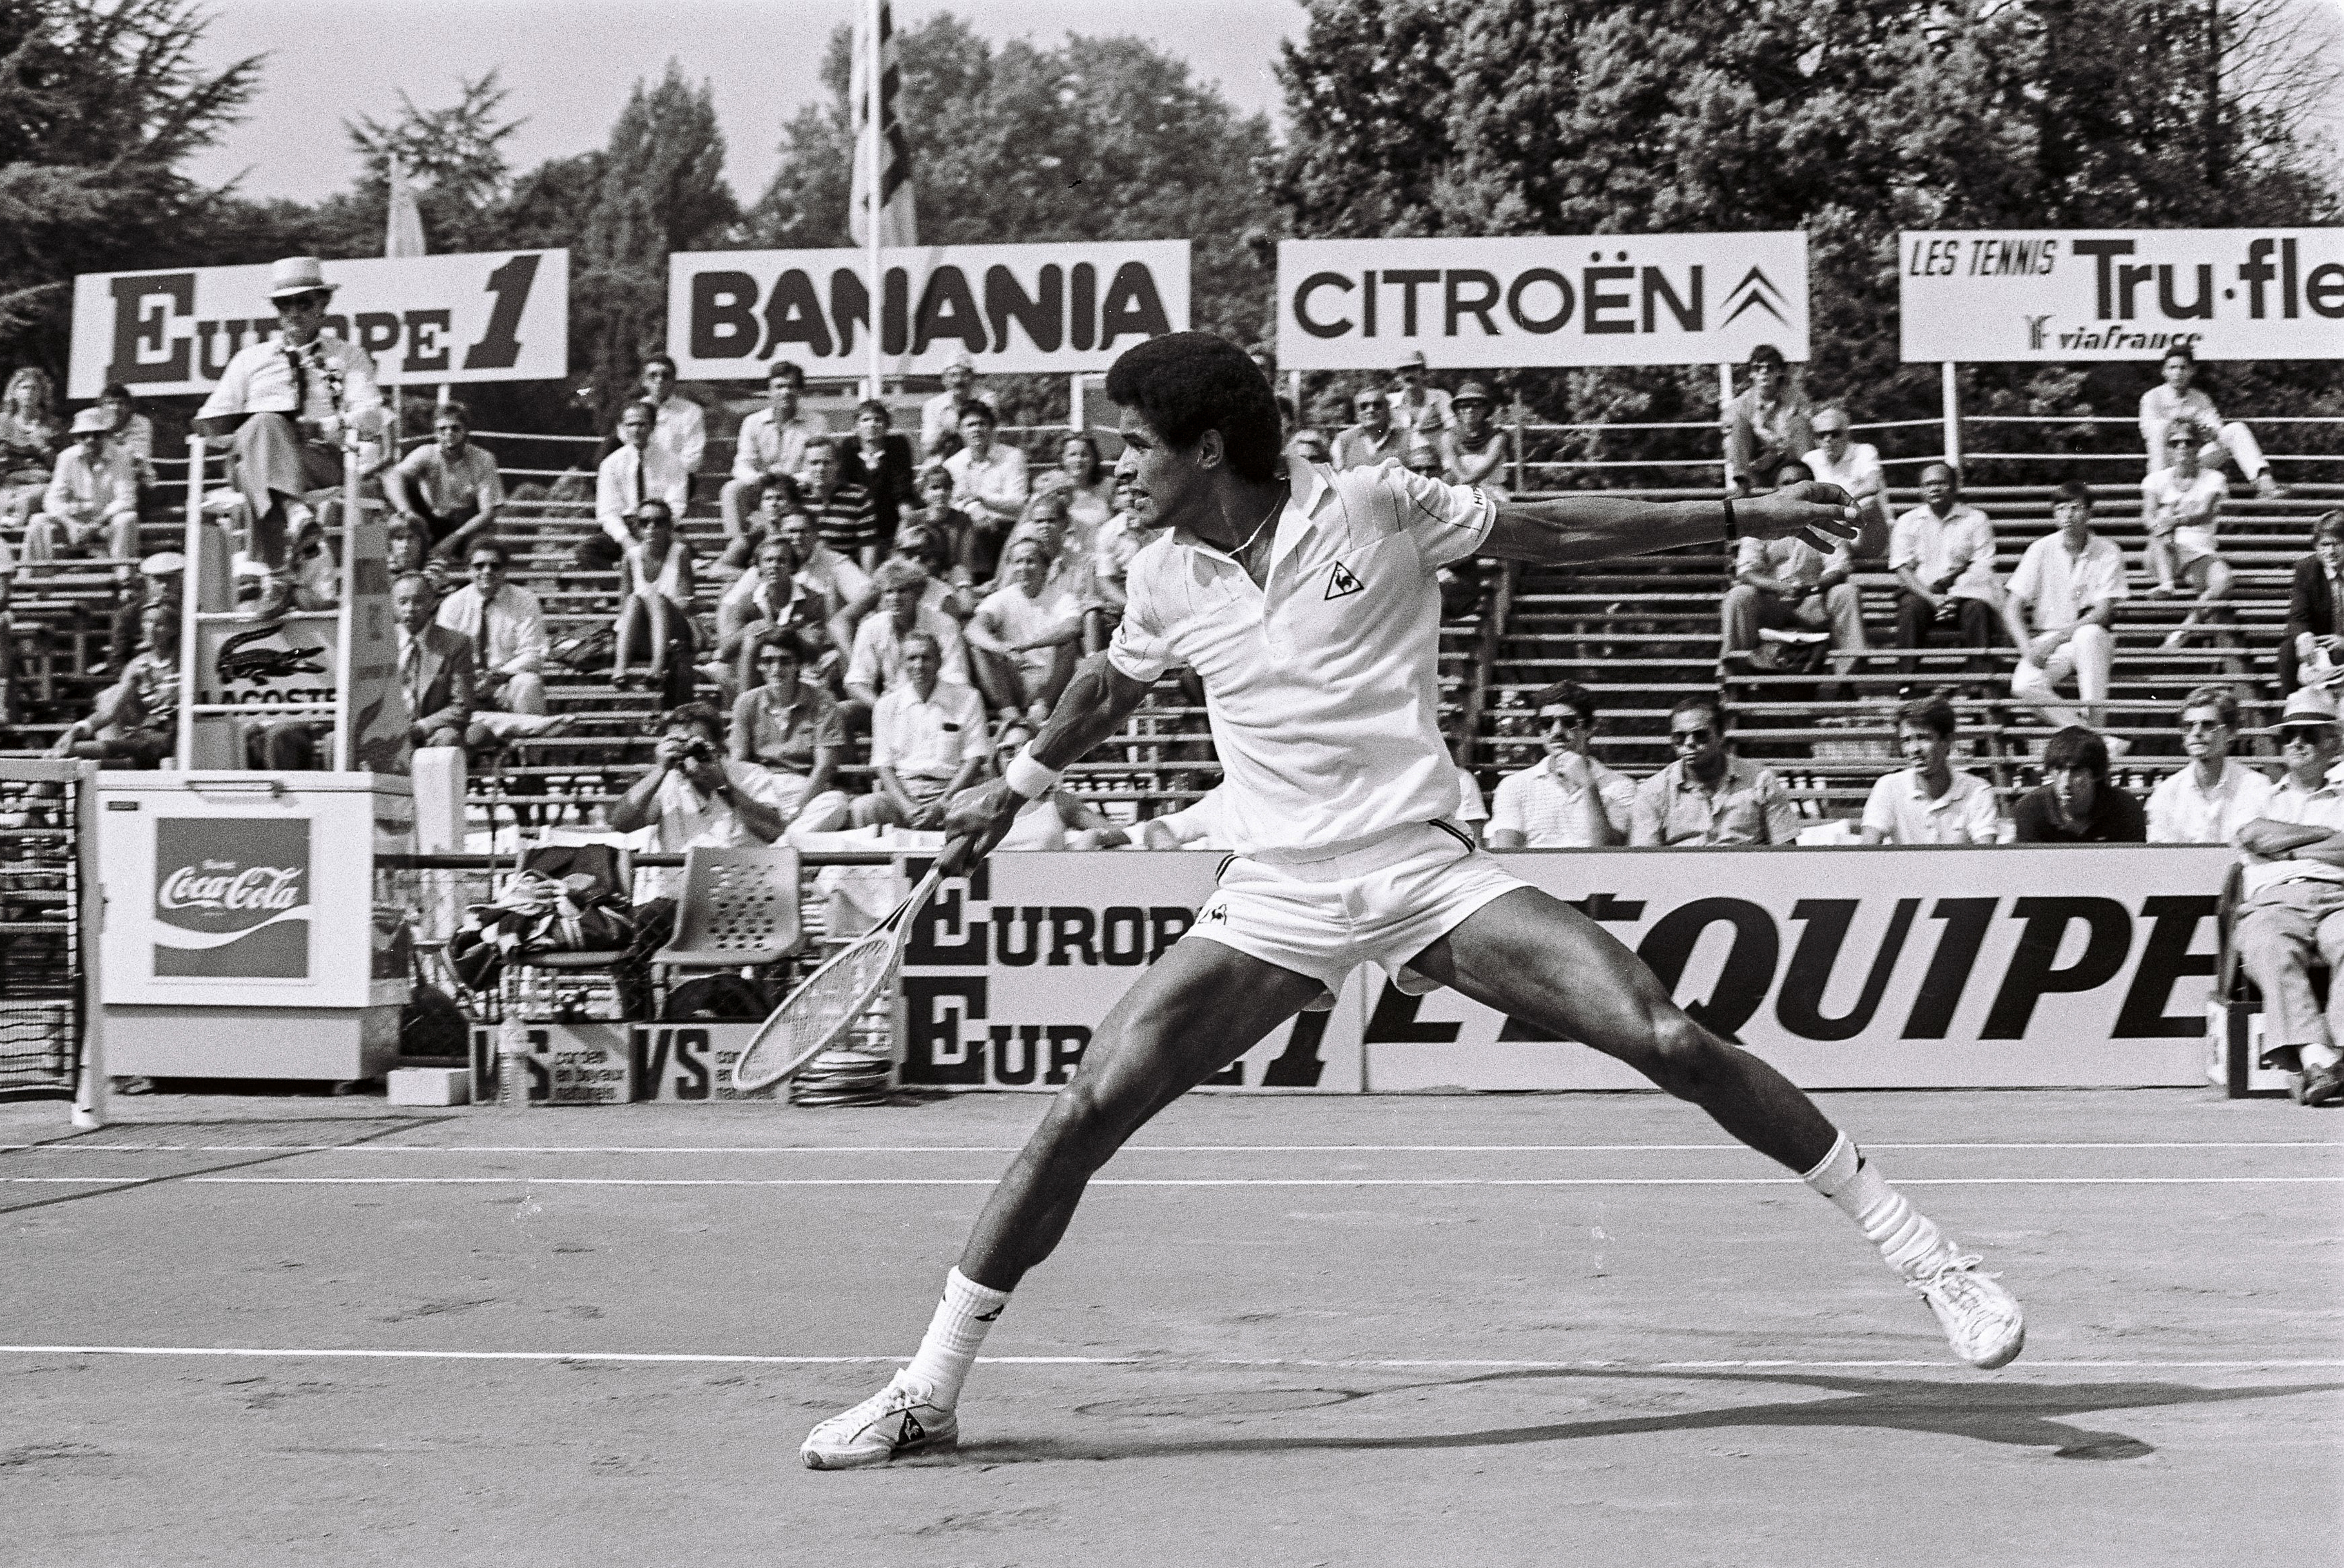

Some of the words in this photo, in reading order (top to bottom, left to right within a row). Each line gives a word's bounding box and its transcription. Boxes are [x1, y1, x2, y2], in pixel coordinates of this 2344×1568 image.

[1293, 251, 1704, 339] CITROËN
[1910, 240, 1958, 276] LES
[1969, 239, 2057, 276] TENNIS
[105, 273, 451, 385] EUPE
[463, 255, 542, 369] 1
[691, 261, 1172, 360] BANANIA
[2060, 325, 2202, 349] viafrance
[904, 857, 1203, 967] EUROP
[632, 1029, 709, 1100] VS
[1261, 1011, 1333, 1087] 1
